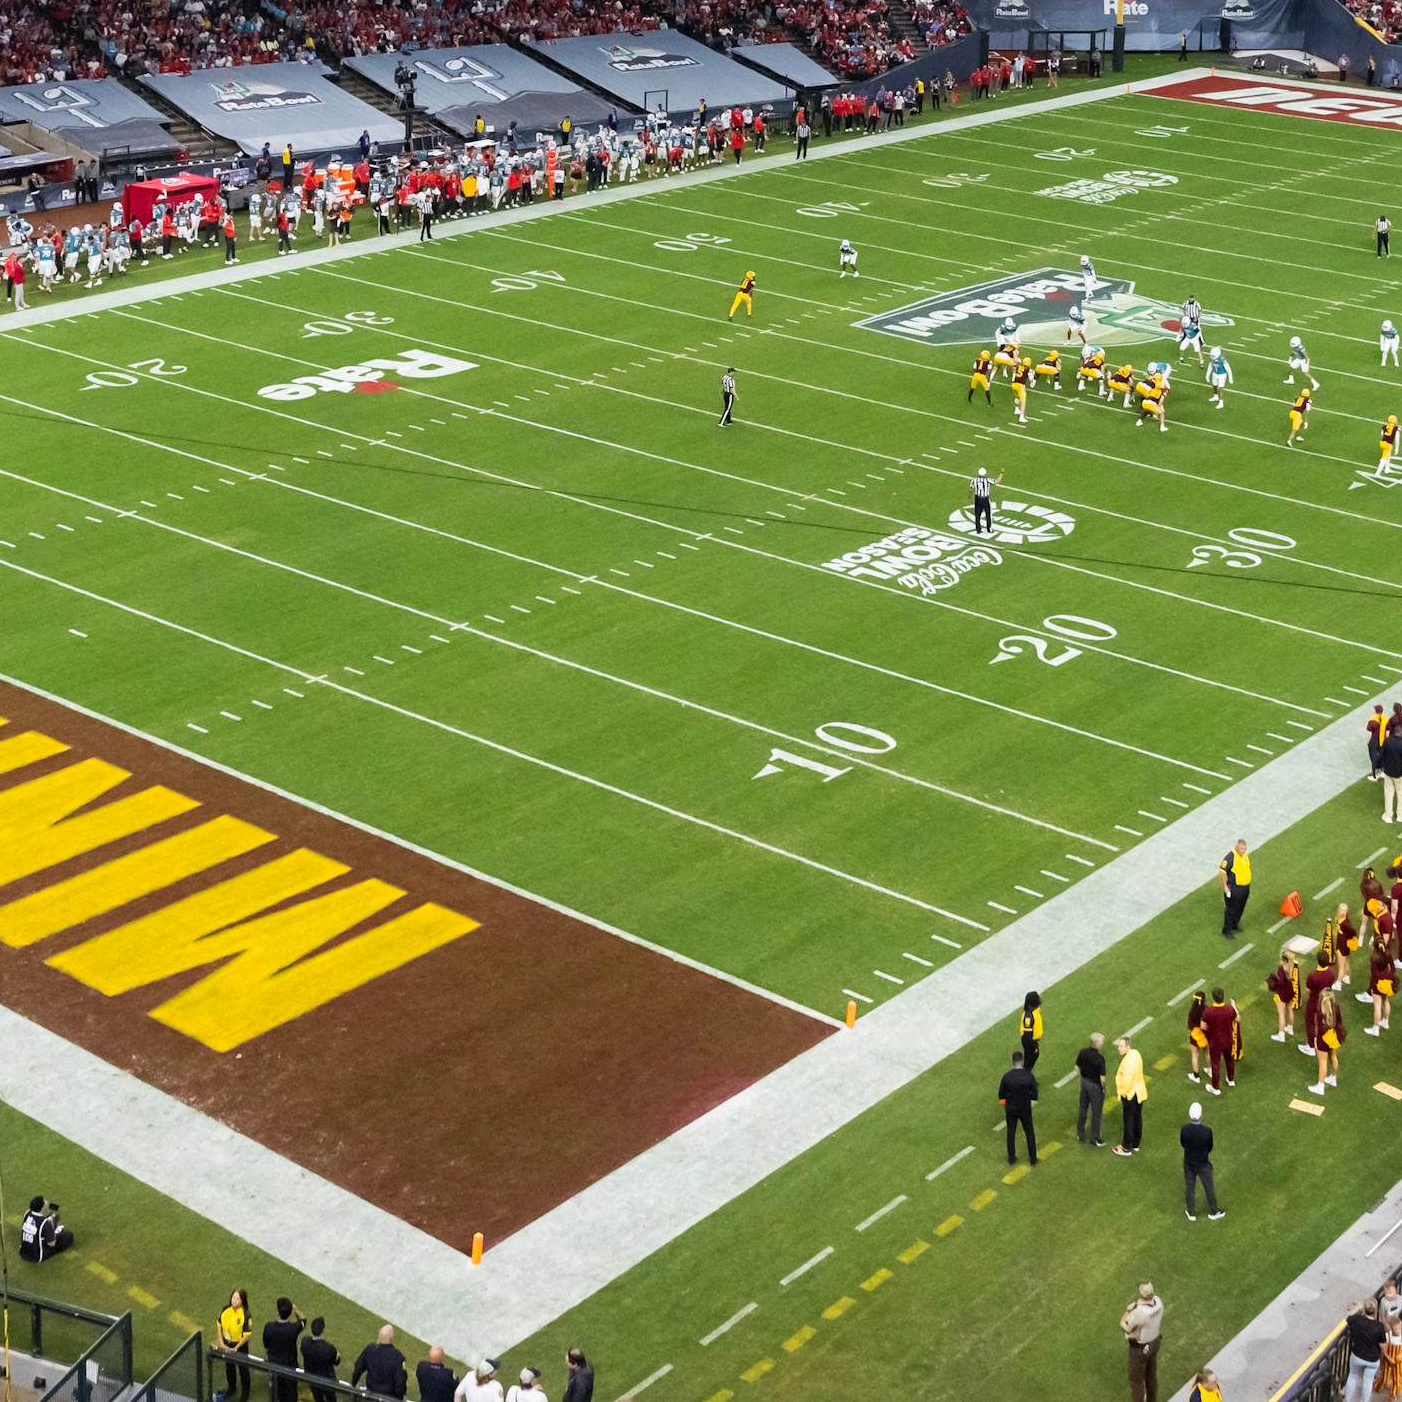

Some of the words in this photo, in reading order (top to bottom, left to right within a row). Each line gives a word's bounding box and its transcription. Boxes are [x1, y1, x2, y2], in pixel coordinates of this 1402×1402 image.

[1134, 124, 1190, 139] 10
[1034, 147, 1094, 161] 20
[922, 172, 985, 188] 30
[795, 201, 860, 218] 40
[654, 232, 731, 252] 50
[493, 270, 566, 292] 40
[303, 310, 394, 338] 30
[85, 358, 188, 390] 20
[257, 349, 480, 401] Rate
[1385, 423, 1393, 436] 3
[821, 526, 932, 573] SEASON
[848, 534, 969, 580] BOWL
[1192, 526, 1298, 570] 30
[1002, 612, 1118, 667] 20
[768, 721, 898, 783] 10
